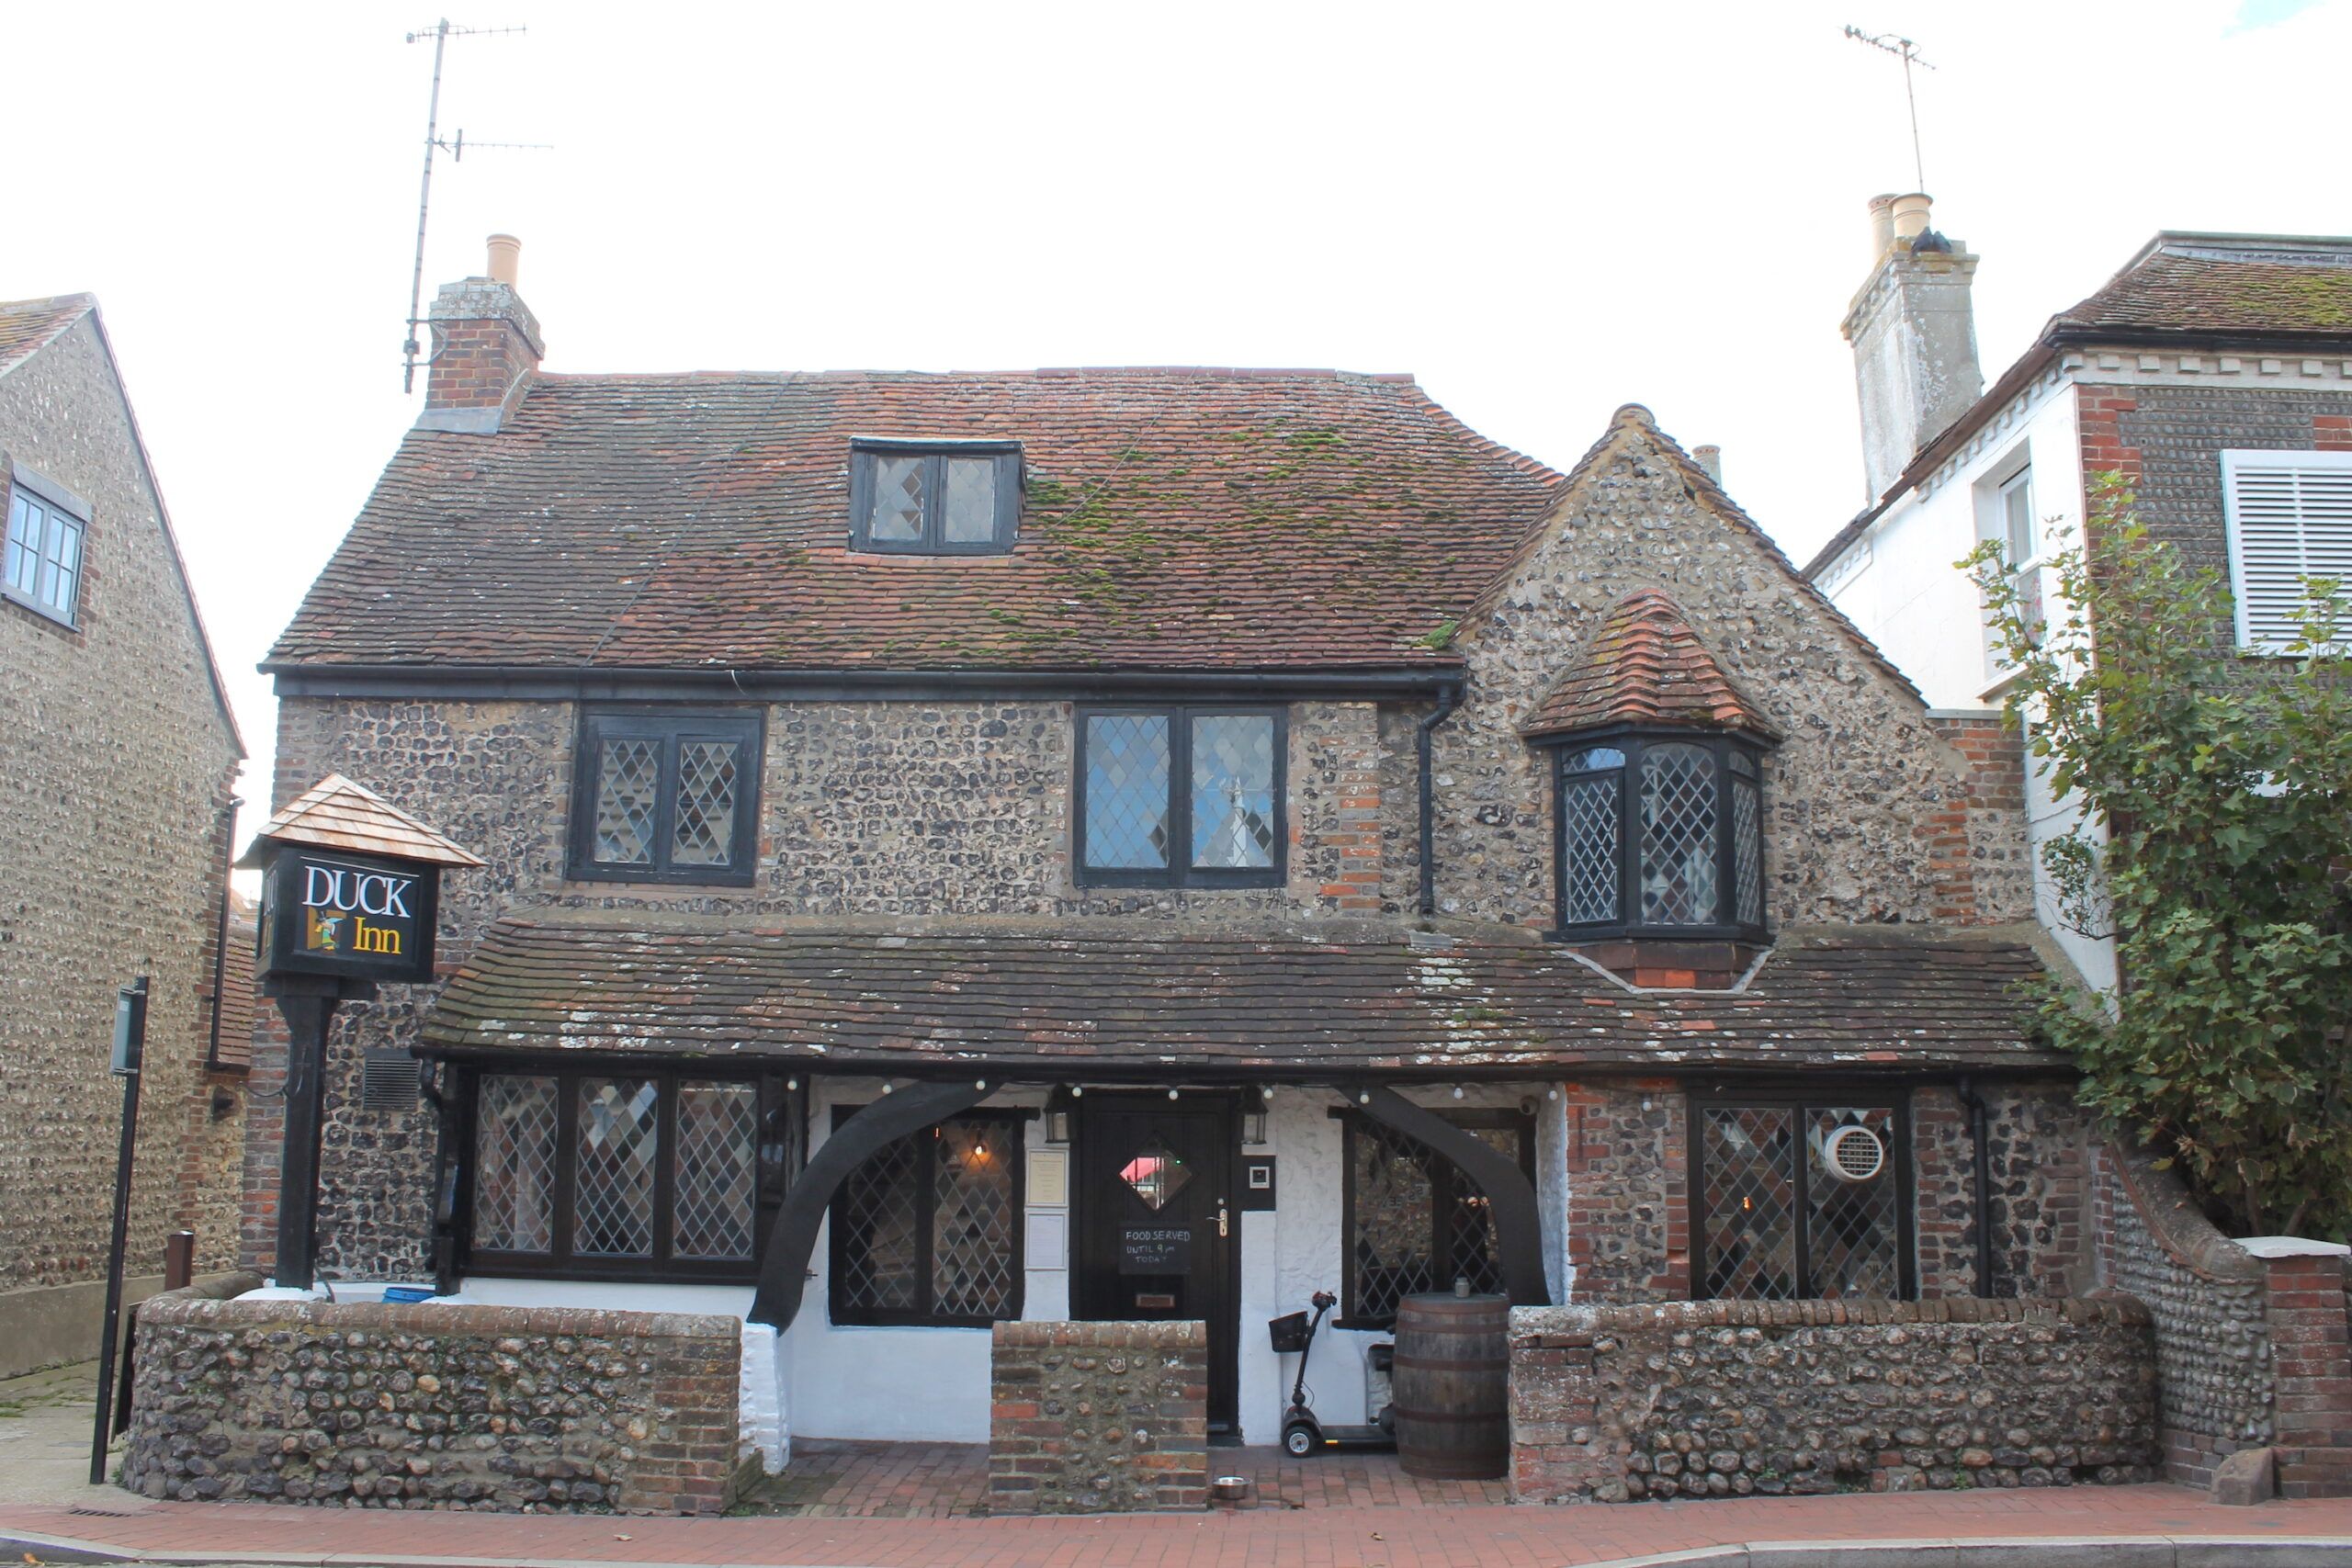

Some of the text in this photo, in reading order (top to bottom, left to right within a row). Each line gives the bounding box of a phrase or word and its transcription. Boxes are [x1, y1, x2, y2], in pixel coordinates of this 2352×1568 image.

[301, 865, 412, 919] DUCK
[352, 916, 402, 954] Inn
[1125, 1230, 1191, 1242] FOOD SERVED
[1126, 1245, 1154, 1254] UNTIL
